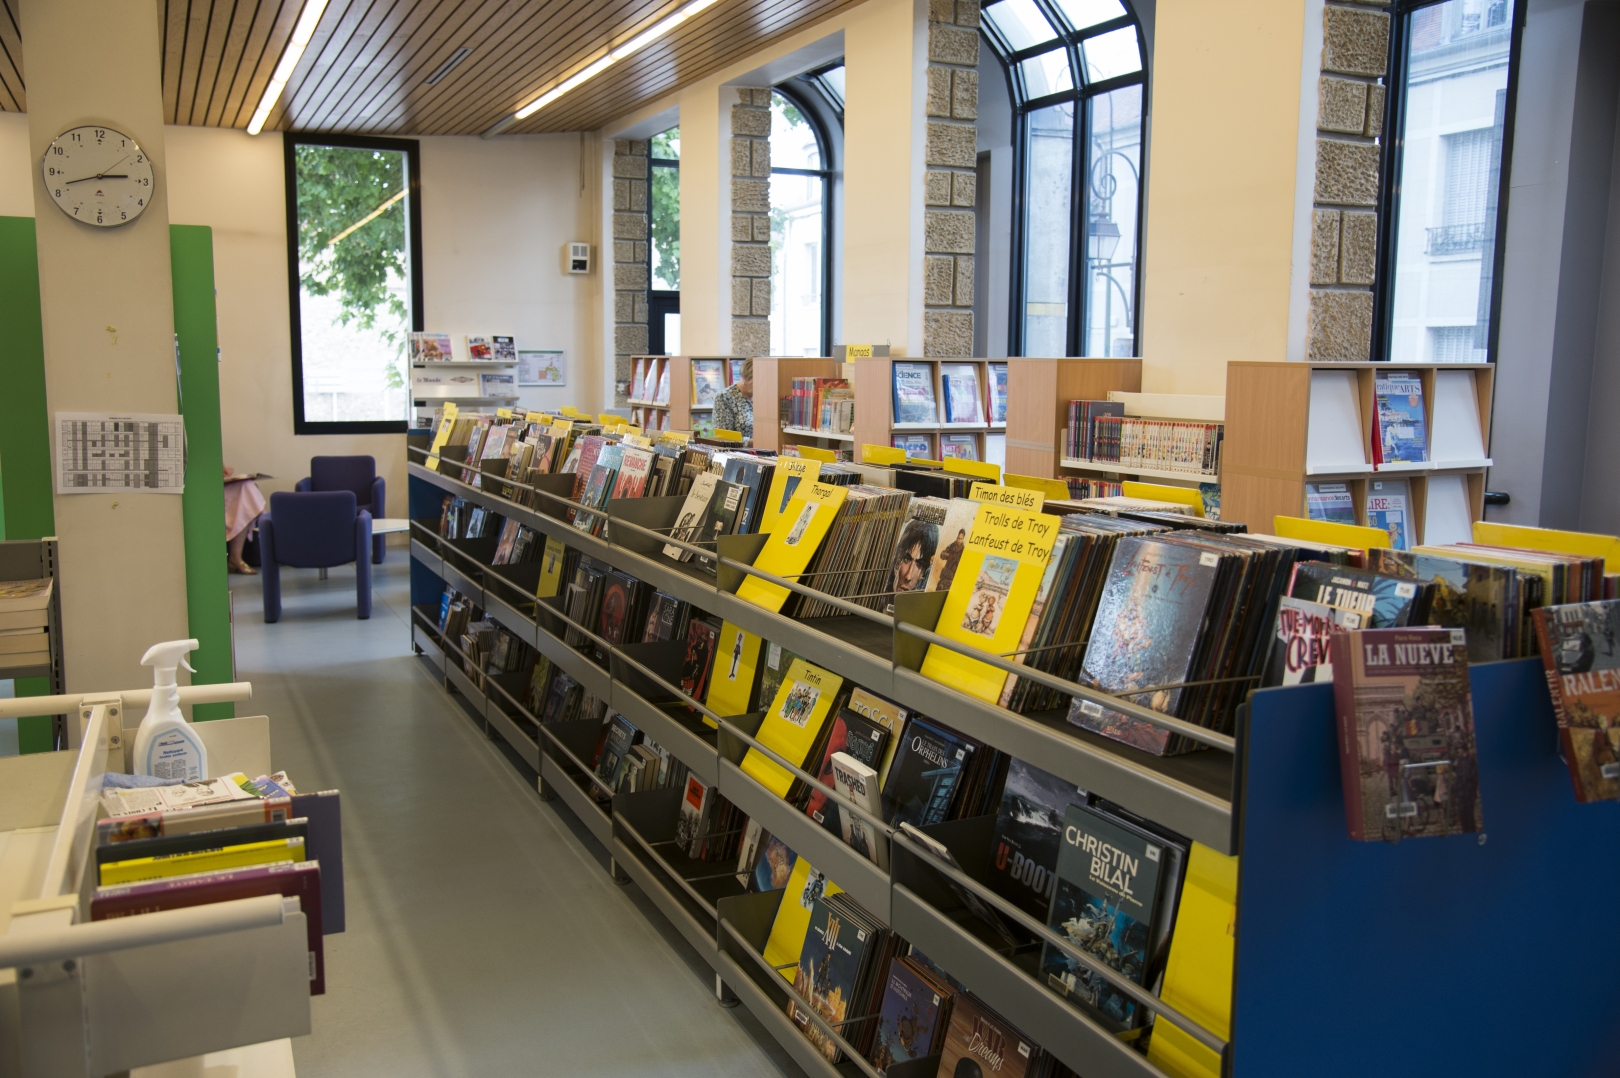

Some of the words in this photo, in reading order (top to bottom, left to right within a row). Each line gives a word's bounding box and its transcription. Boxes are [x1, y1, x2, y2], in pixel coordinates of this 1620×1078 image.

[71, 132, 81, 142] 11
[94, 129, 105, 139] 12
[53, 146, 63, 156] 10
[120, 139, 125, 148] 1
[136, 154, 143, 163] 2
[48, 167, 55, 176] 9
[143, 178, 149, 187] 3
[55, 189, 61, 198] 8
[137, 198, 144, 207] 4
[73, 207, 79, 215] 7
[120, 211, 127, 220] 5
[96, 215, 103, 224] 6
[623, 454, 647, 472] REVANCHE
[811, 484, 834, 499] Thorgal
[975, 487, 998, 502] Timon
[1000, 490, 1014, 504] des
[1016, 492, 1035, 507] blés
[984, 511, 1009, 528] Trolls
[1011, 515, 1023, 530] de
[1027, 518, 1050, 538] Troy
[968, 531, 1010, 550] Lanfeust
[1010, 540, 1023, 554] de
[1027, 542, 1050, 563] Troy
[1364, 644, 1391, 666] LA
[1394, 643, 1454, 665] NUEVE
[805, 669, 822, 685] Tintin
[1545, 670, 1568, 729] RALENTIR
[926, 742, 938, 752] TRAIN
[937, 747, 945, 756] DES
[834, 766, 866, 796] TRASHED
[1065, 825, 1139, 877] CHRISTIN
[995, 841, 1055, 900] U-BOOT
[1090, 856, 1133, 895] BILAL
[1089, 874, 1096, 882] Le
[1125, 893, 1143, 908] Pierre
[822, 911, 841, 951] XIII
[968, 1032, 1005, 1071] Dreams
